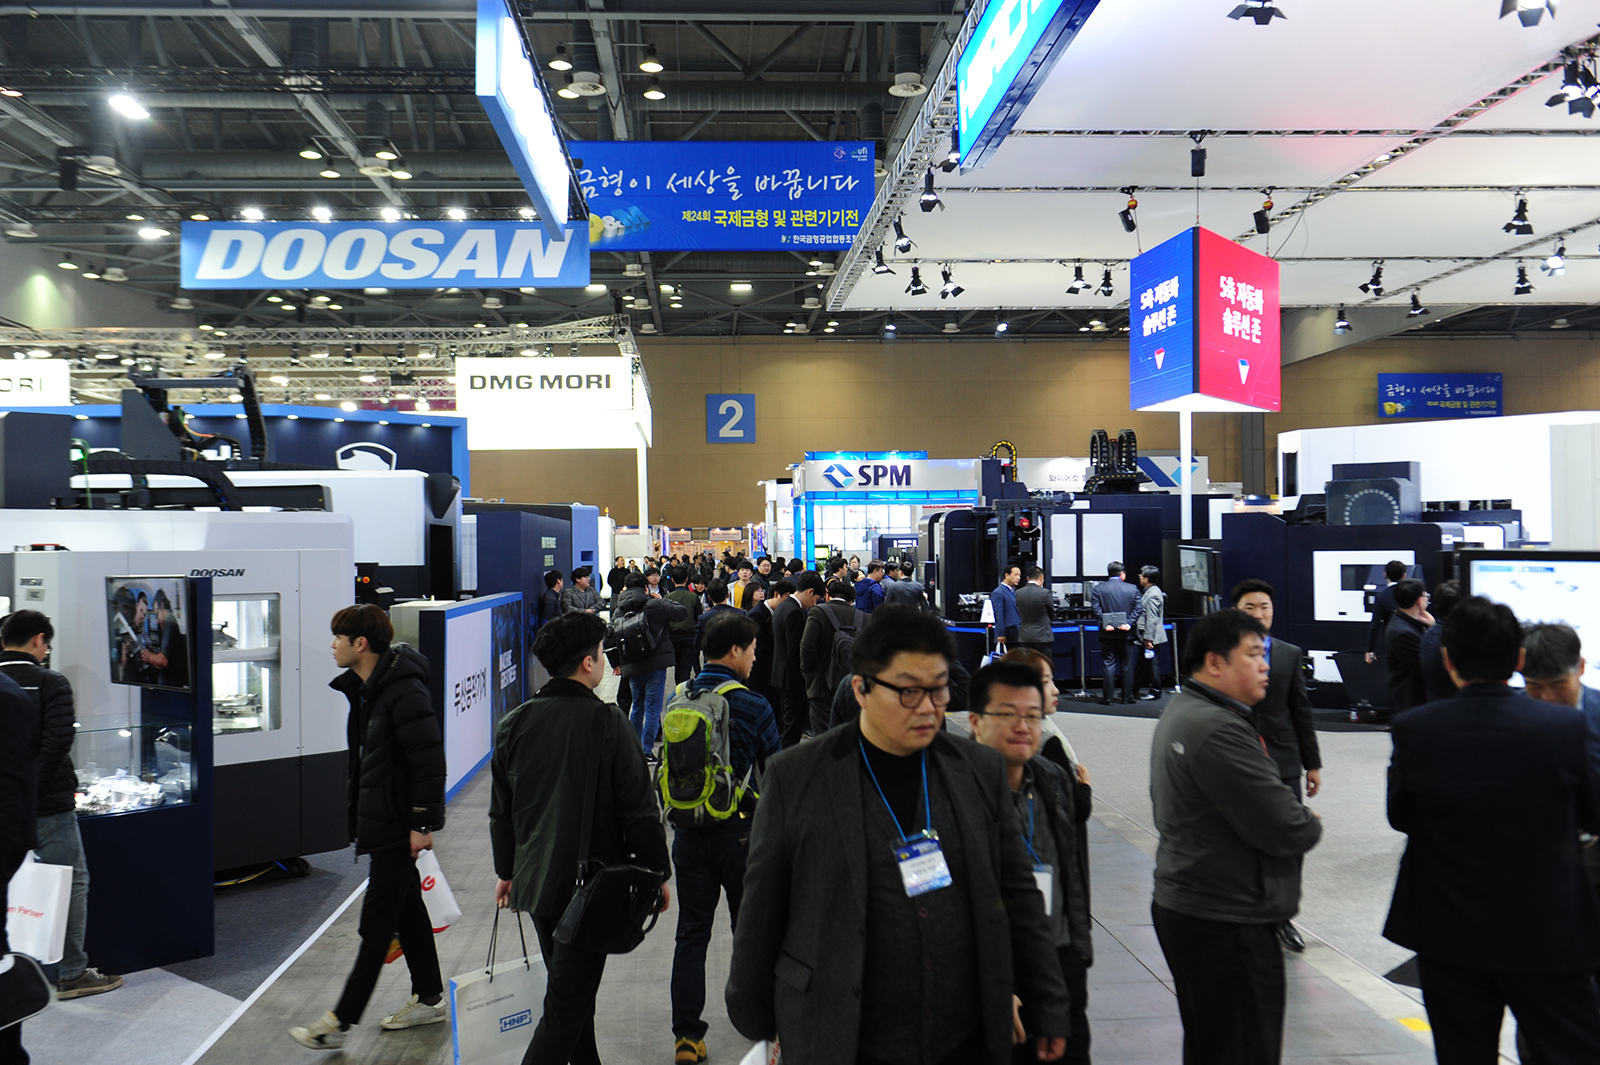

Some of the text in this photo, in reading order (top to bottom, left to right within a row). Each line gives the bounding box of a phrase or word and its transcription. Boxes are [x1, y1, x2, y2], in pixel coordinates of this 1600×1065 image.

[578, 165, 860, 201] 금형이 세상을 바꿉니다
[681, 209, 860, 228] 제24회 국제금형 및 관련기기전
[195, 228, 574, 281] DOOSAN
[1219, 275, 1236, 305] 5축
[1251, 317, 1262, 344] 존
[469, 374, 611, 390] DMG MORI
[718, 399, 744, 438] 2
[858, 464, 911, 487] SPM
[190, 568, 246, 577] DOOSAN
[454, 667, 487, 717] 두산공작기계
[503, 1013, 529, 1030] HNP
